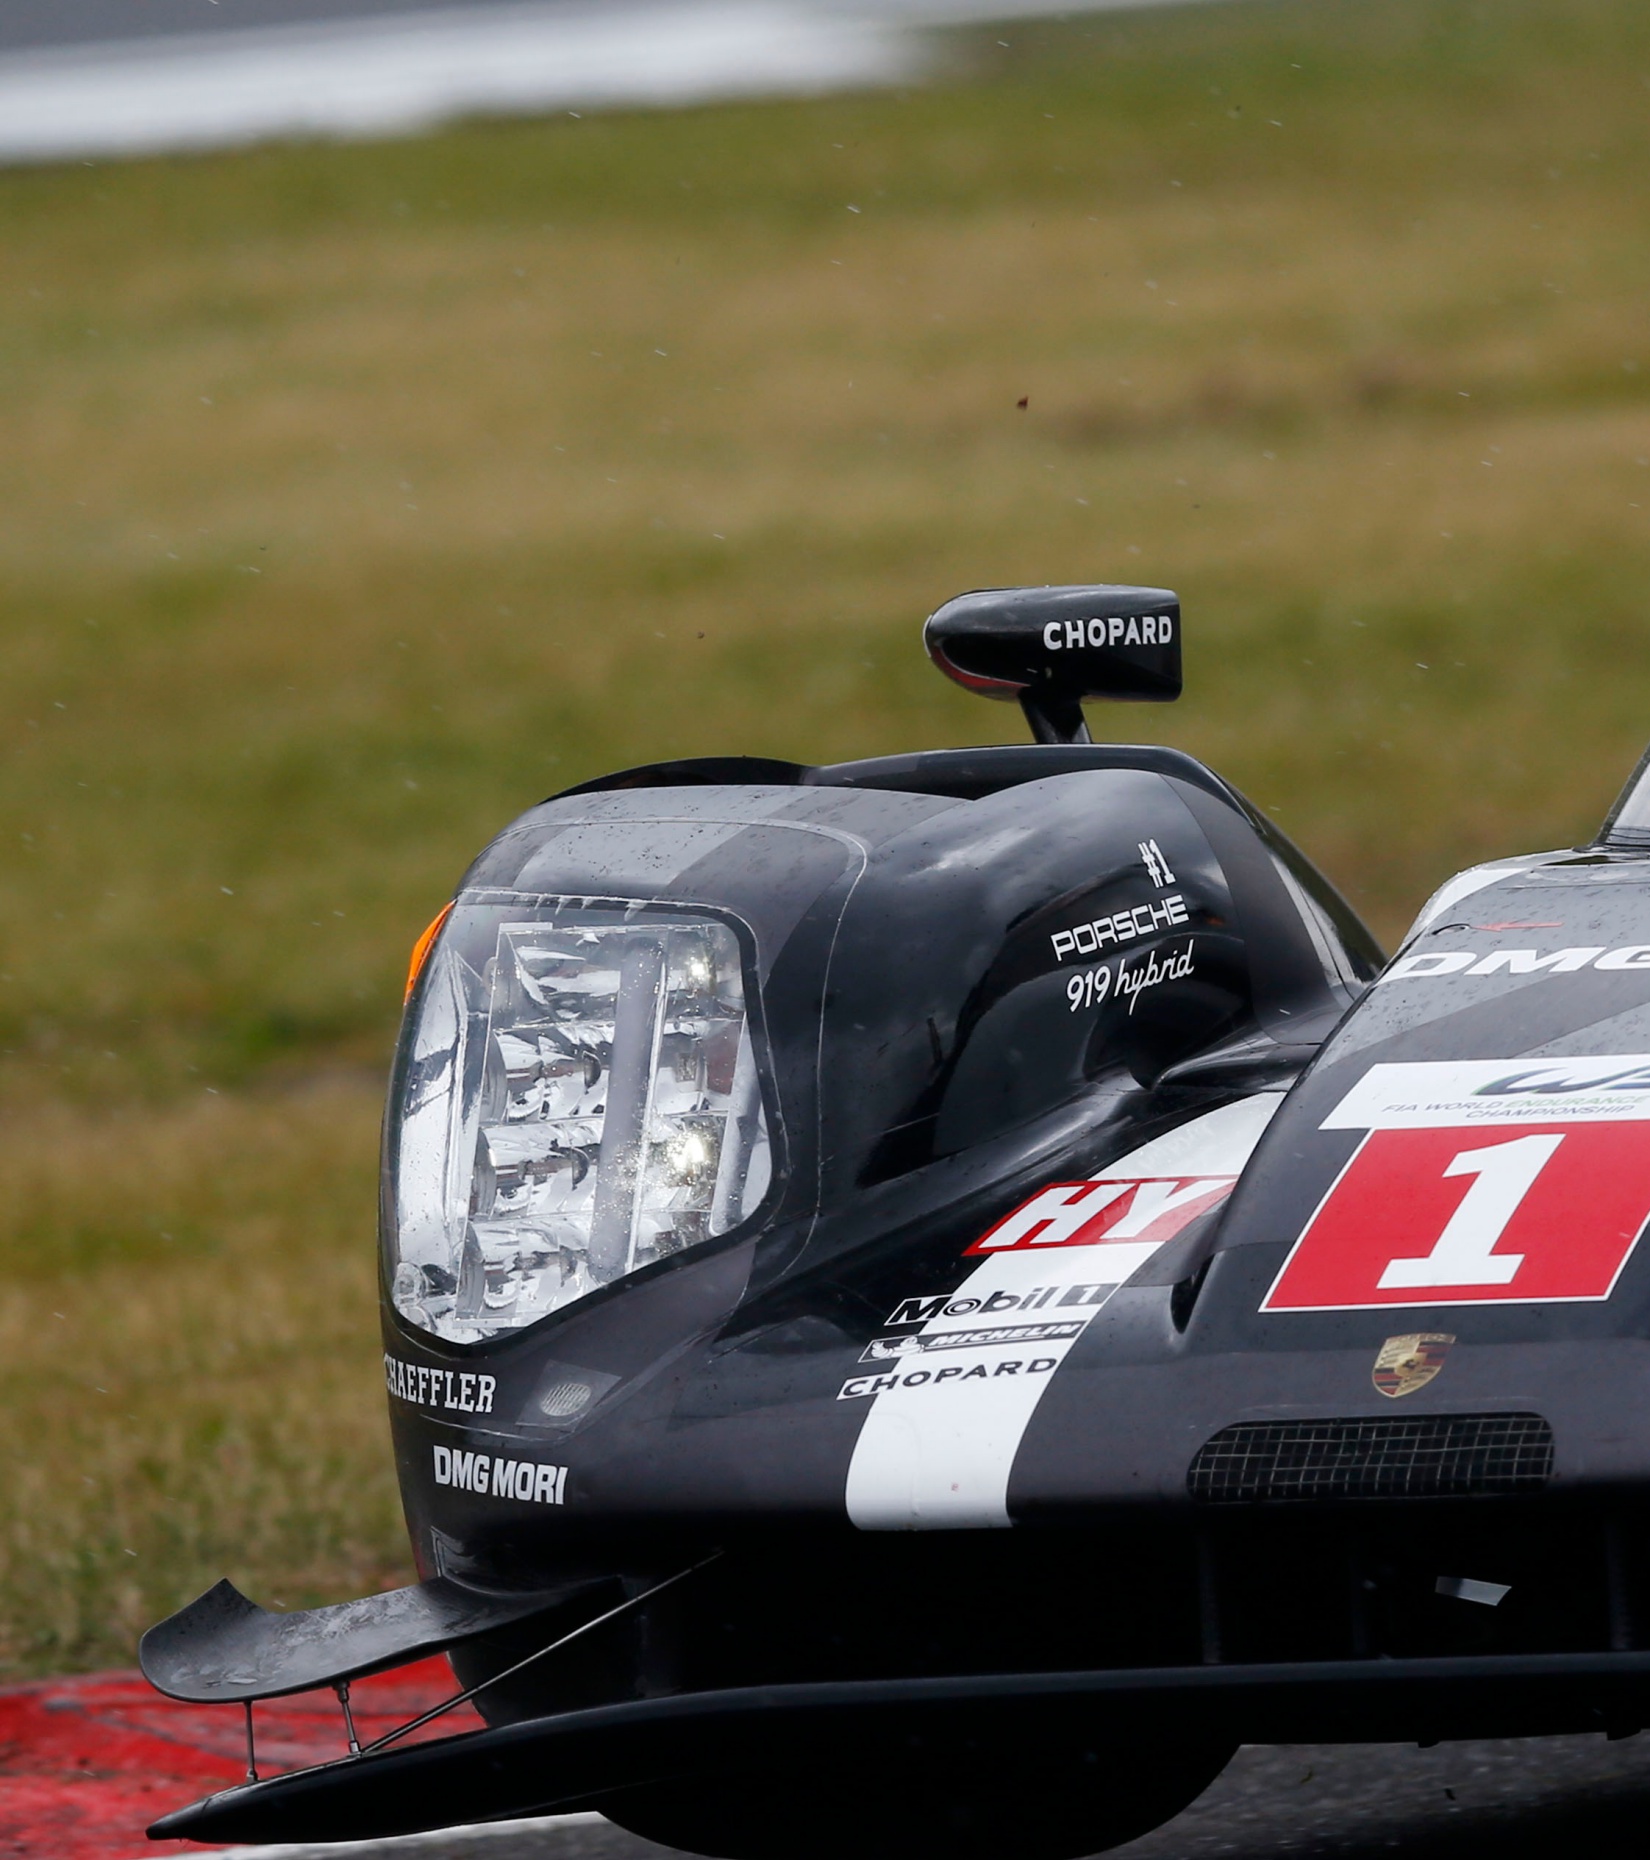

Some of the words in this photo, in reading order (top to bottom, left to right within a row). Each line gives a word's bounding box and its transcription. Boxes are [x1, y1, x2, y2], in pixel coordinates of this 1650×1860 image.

[1043, 616, 1173, 650] CHOPARD
[1138, 838, 1176, 888] #1
[1051, 895, 1189, 961] PORSCHE
[1066, 965, 1112, 1012] 919
[1113, 938, 1195, 1016] hybrid
[1381, 1103, 1418, 1114] FIA
[1424, 1100, 1504, 1113] WORLD
[1466, 1104, 1636, 1119] CHAMPIONSHIP
[978, 1179, 1236, 1249] HY
[1375, 1132, 1567, 1289] 1
[889, 1285, 1060, 1323] Mobil
[926, 1321, 1084, 1347] MICHELIN
[842, 1357, 1058, 1398] CHOPARD
[433, 1445, 490, 1494] DMG
[492, 1457, 568, 1505] MORI
